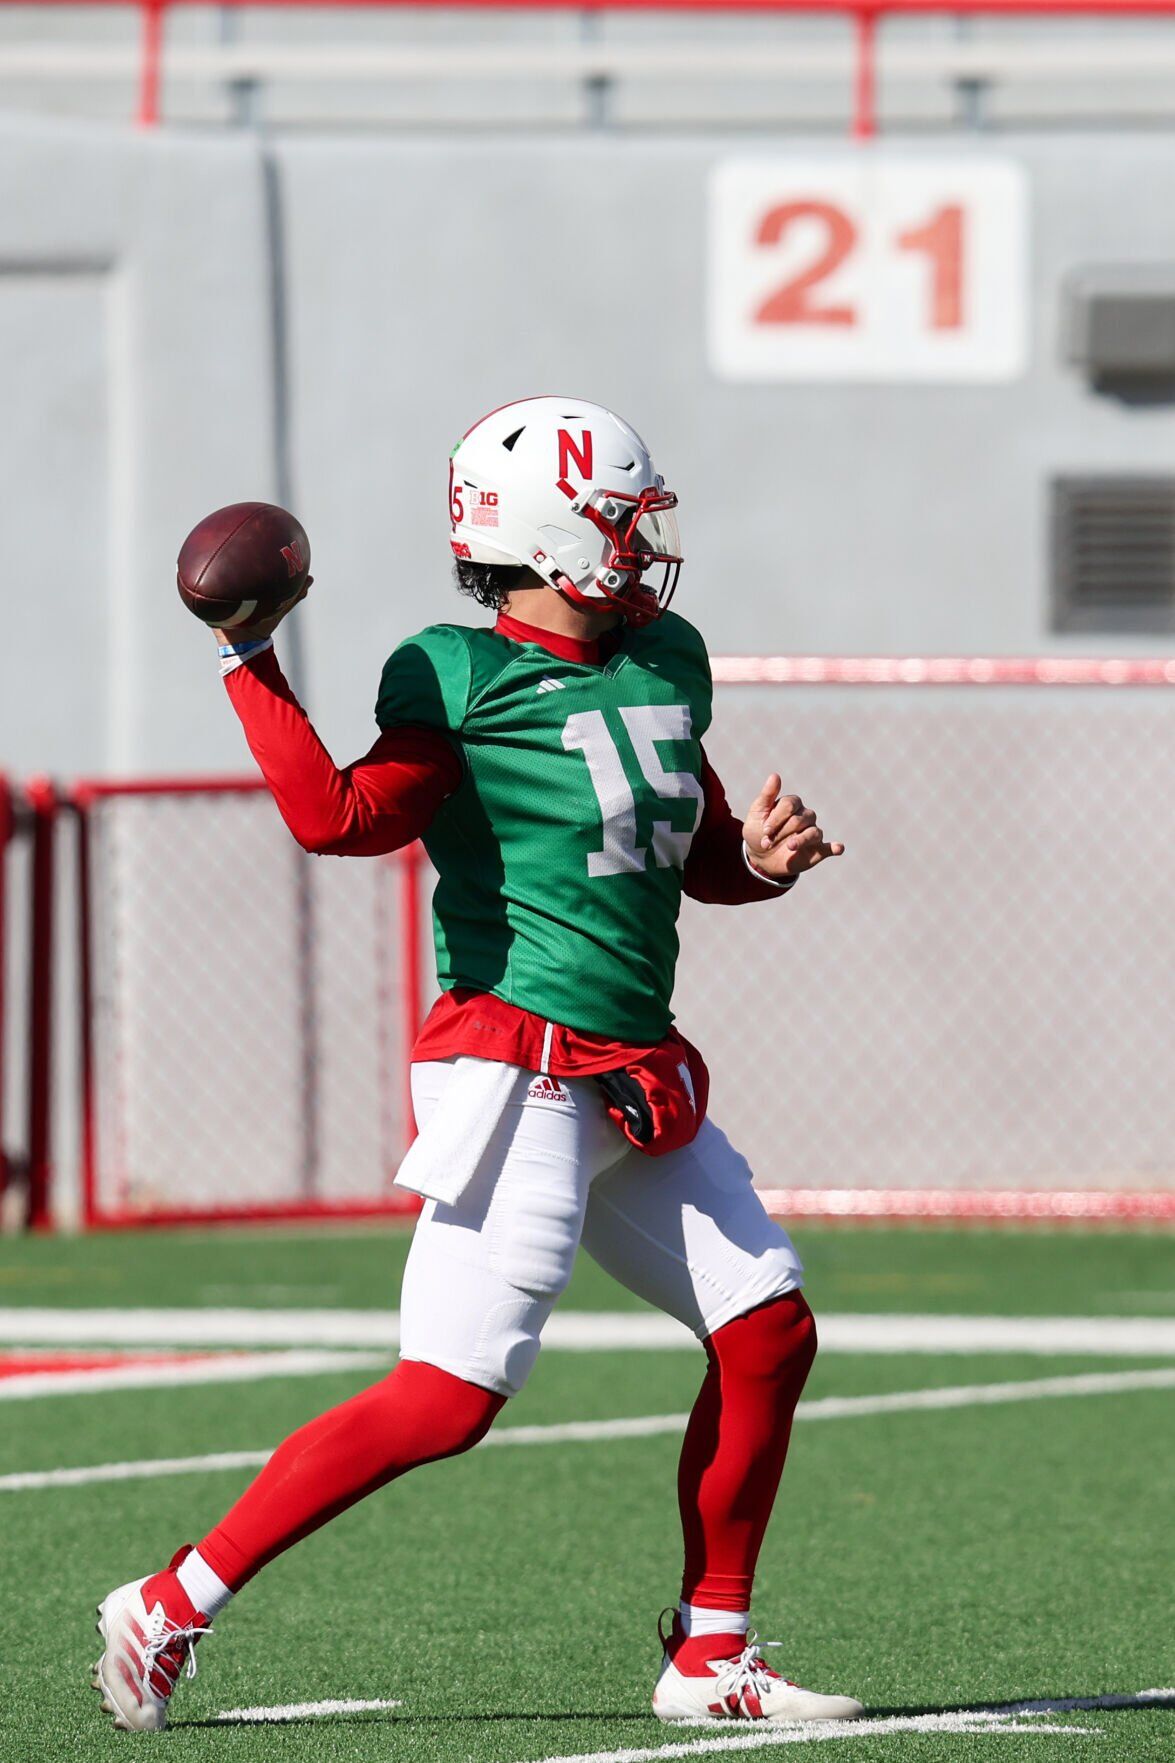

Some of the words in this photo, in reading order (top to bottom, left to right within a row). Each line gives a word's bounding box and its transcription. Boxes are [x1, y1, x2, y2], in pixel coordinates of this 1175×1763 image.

[753, 199, 965, 331] 21
[556, 428, 593, 481] N
[279, 540, 304, 578] N
[560, 704, 705, 878] 15
[528, 1089, 567, 1102] adidas
